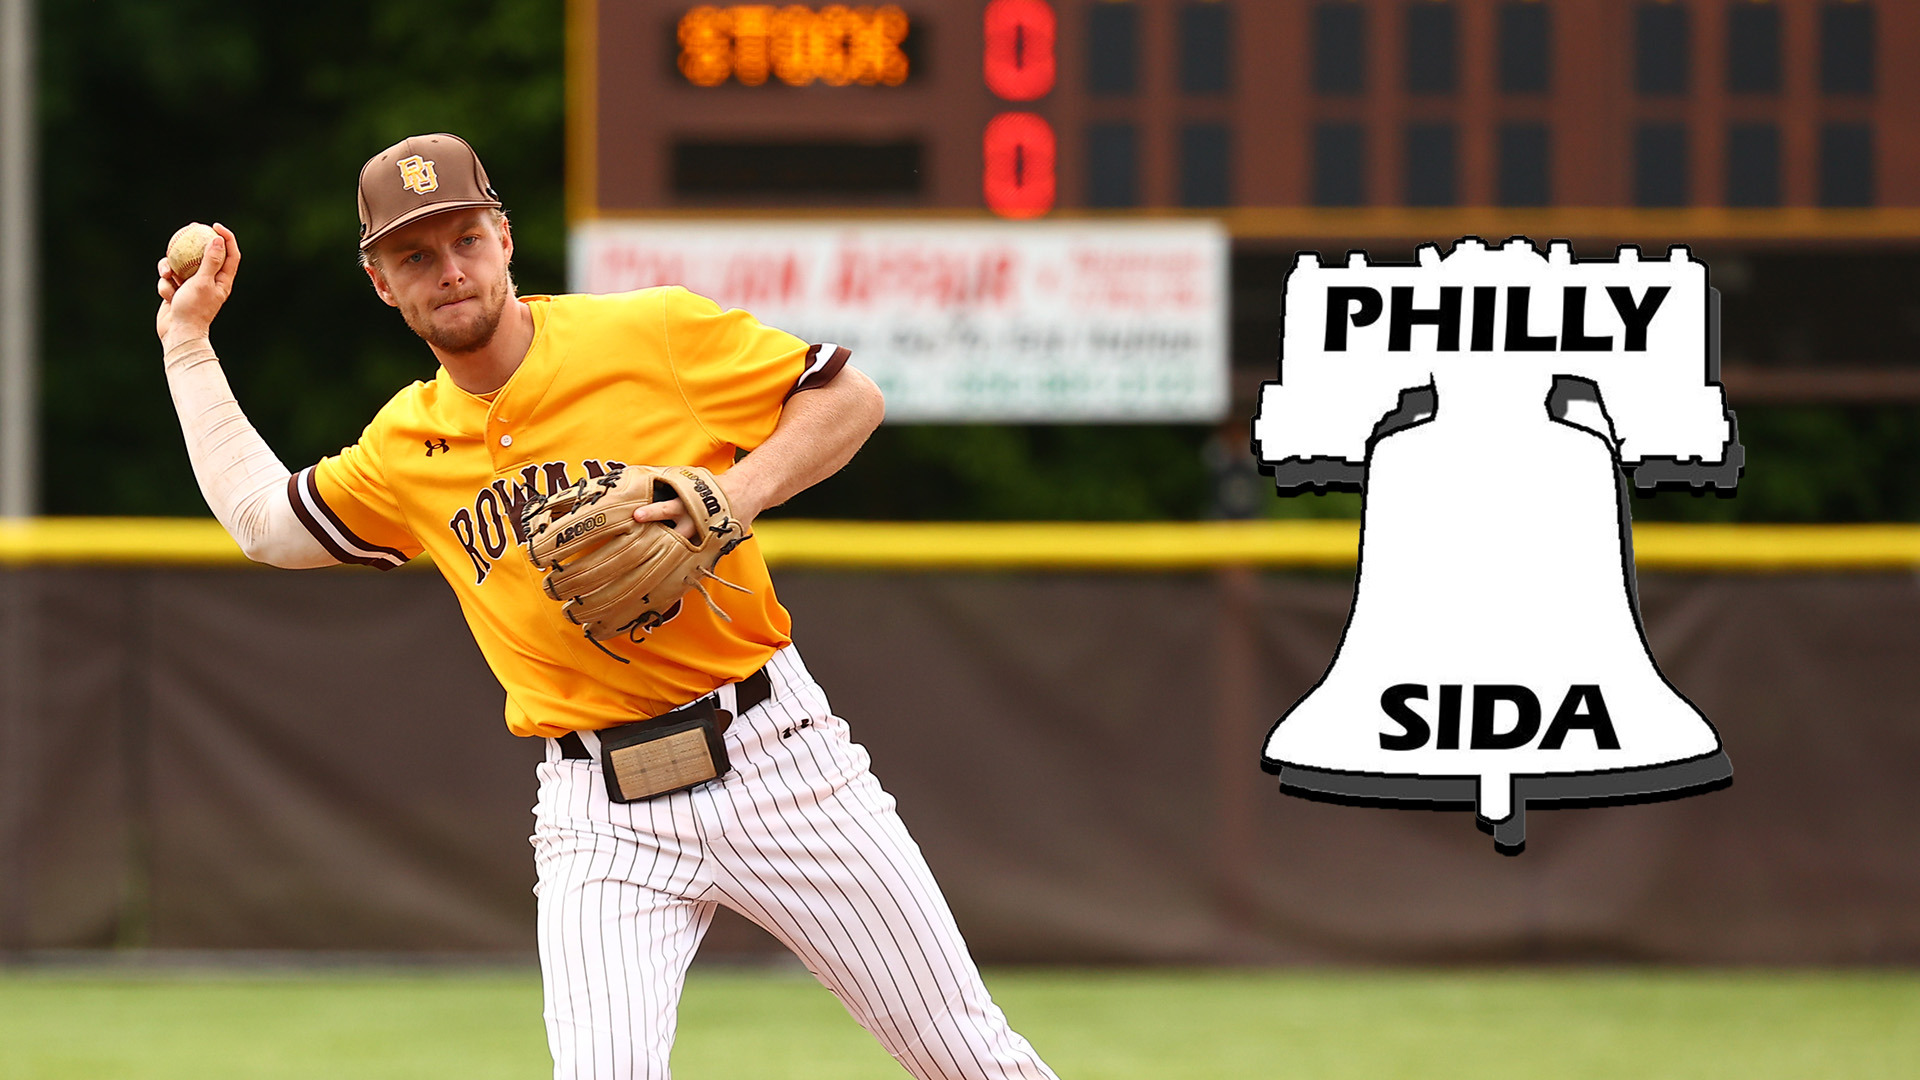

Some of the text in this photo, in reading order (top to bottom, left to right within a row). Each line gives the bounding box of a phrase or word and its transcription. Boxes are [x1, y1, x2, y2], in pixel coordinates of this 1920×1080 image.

[983, 0, 1057, 100] 0
[397, 154, 439, 195] RU
[983, 111, 1057, 220] 0
[450, 459, 628, 585] ROW
[555, 512, 607, 548] A2000
